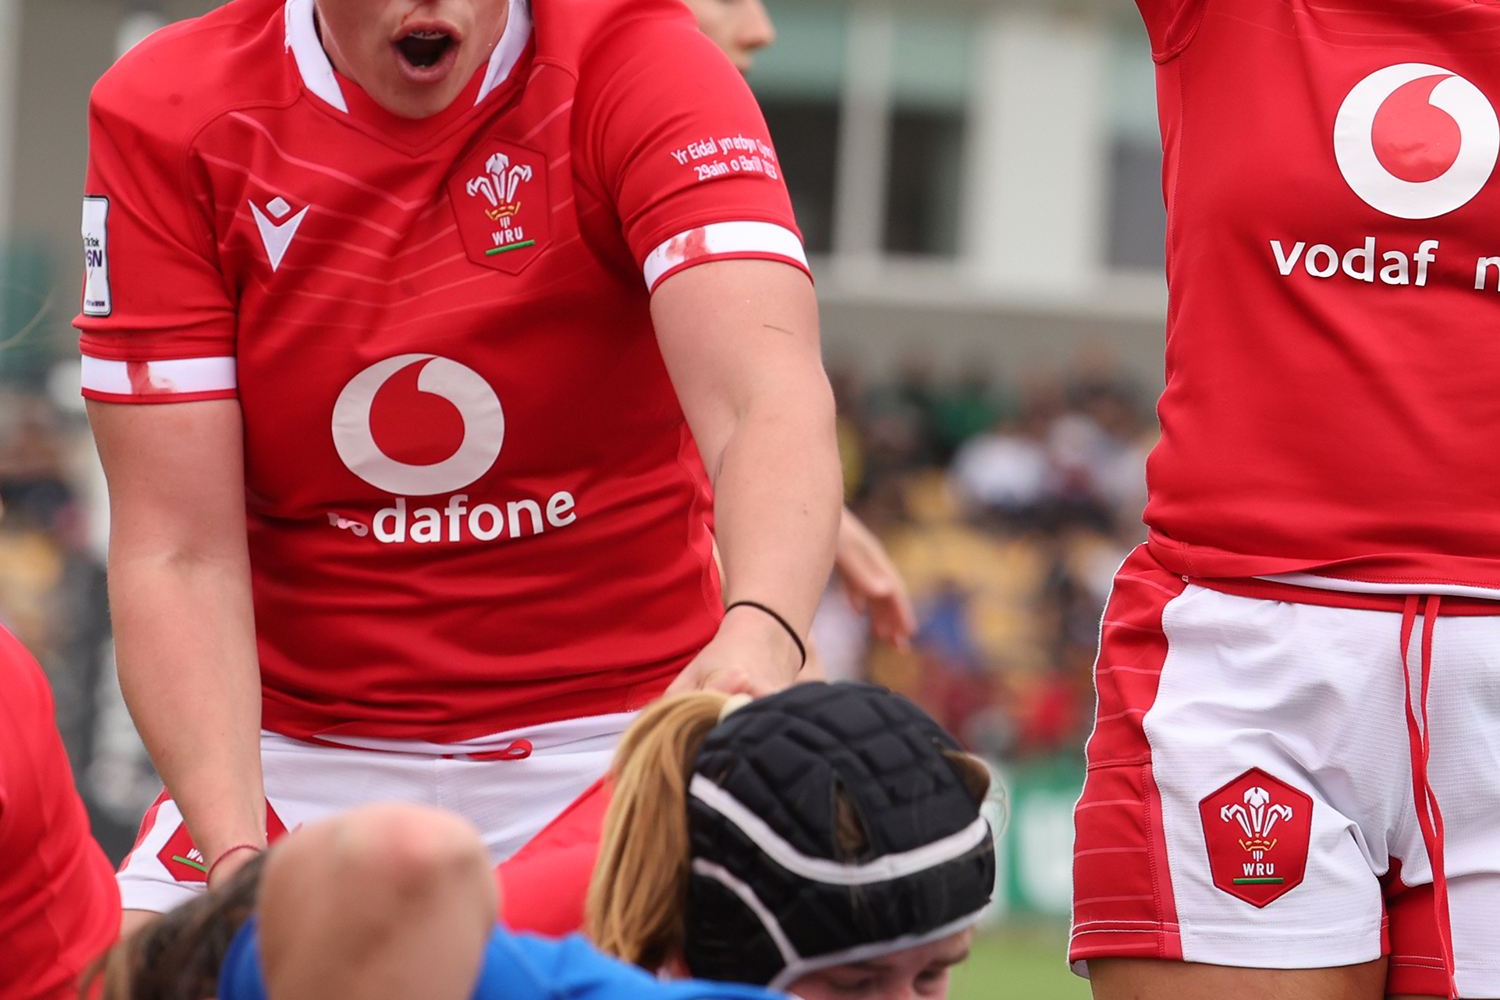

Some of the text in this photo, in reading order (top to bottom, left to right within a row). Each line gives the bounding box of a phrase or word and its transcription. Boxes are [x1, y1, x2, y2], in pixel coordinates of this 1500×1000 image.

[670, 149, 689, 165] Yr
[687, 137, 718, 160] Eidal
[693, 160, 730, 181] 29ain
[730, 159, 741, 171] o
[492, 226, 524, 246] WRU
[327, 490, 577, 543] dafone
[1242, 862, 1275, 877] WRU
